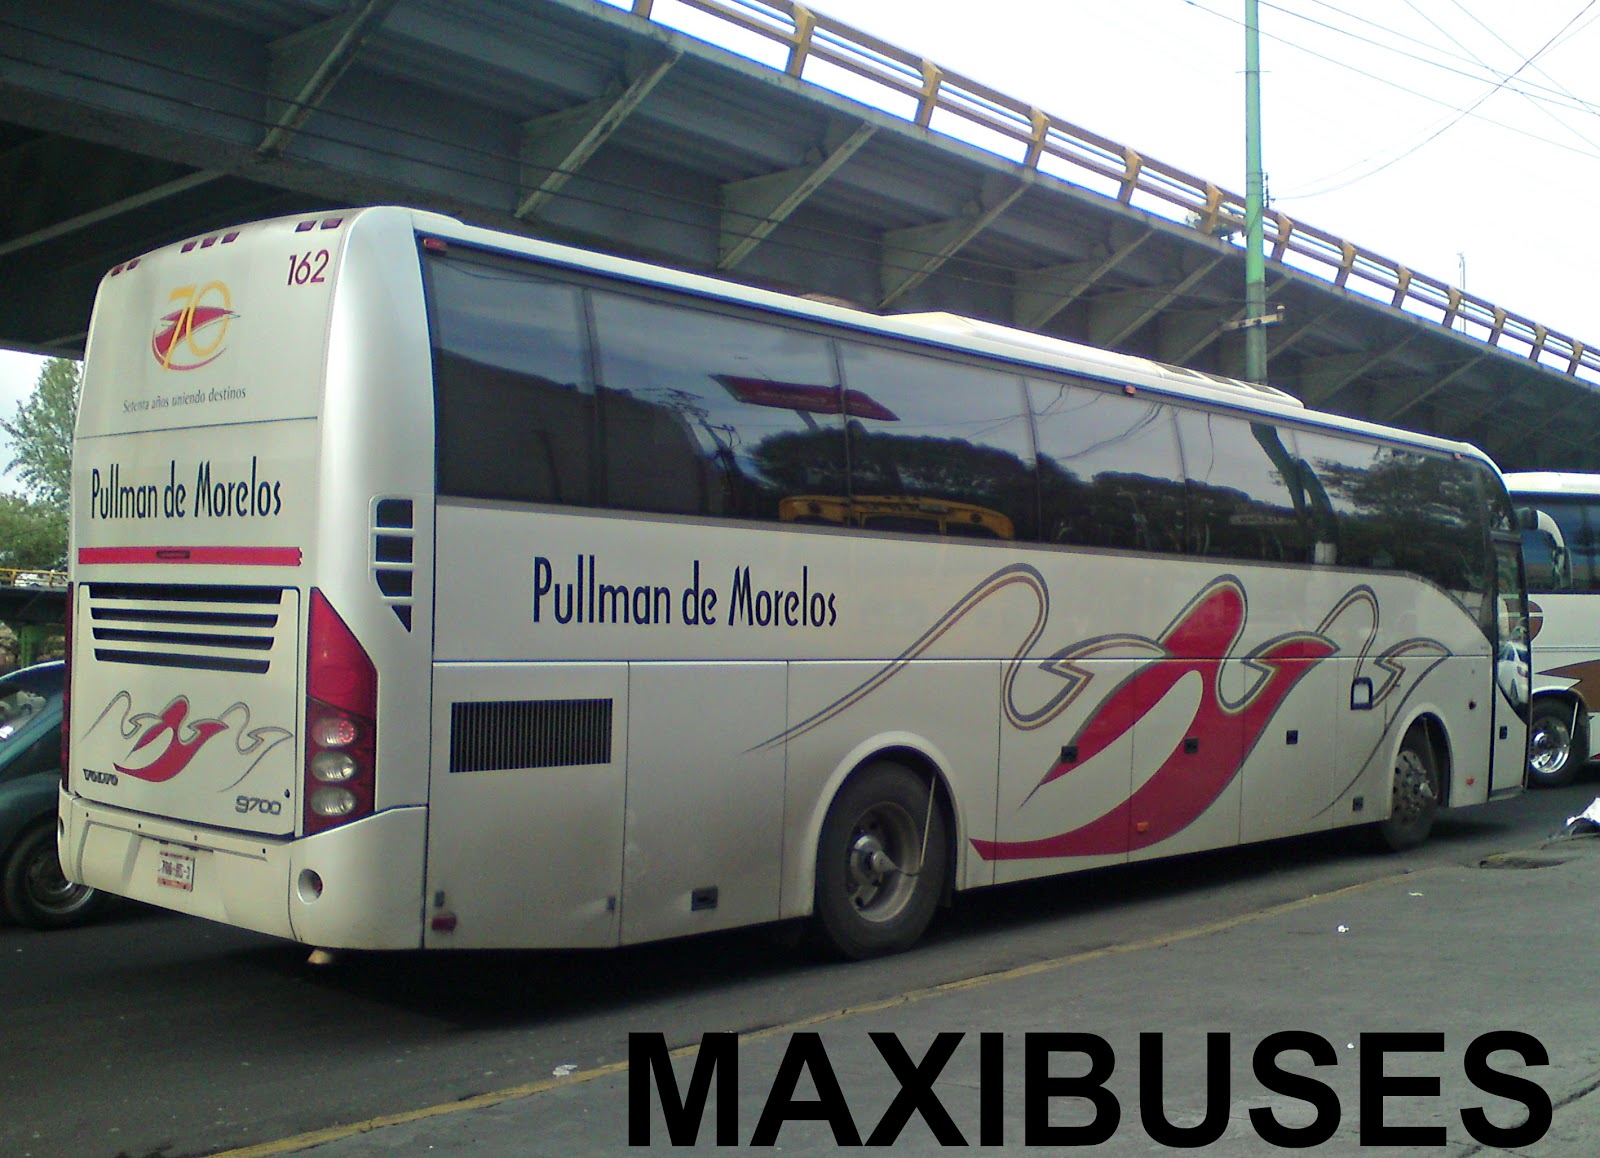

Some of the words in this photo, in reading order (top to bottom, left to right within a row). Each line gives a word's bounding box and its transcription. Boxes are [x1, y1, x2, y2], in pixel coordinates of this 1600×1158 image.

[287, 249, 330, 286] 162
[163, 279, 232, 370] 70
[123, 399, 150, 414] Setenta
[151, 395, 169, 409] años
[172, 389, 206, 407] uniendo
[208, 386, 246, 402] destinos
[91, 463, 158, 520] Pullman
[164, 460, 186, 519] de
[194, 456, 282, 518] Morelos
[533, 554, 672, 625] Pullman
[682, 560, 717, 626] de
[728, 565, 837, 627] Morelos
[82, 768, 119, 786] VOLVO
[235, 795, 282, 816] 9700
